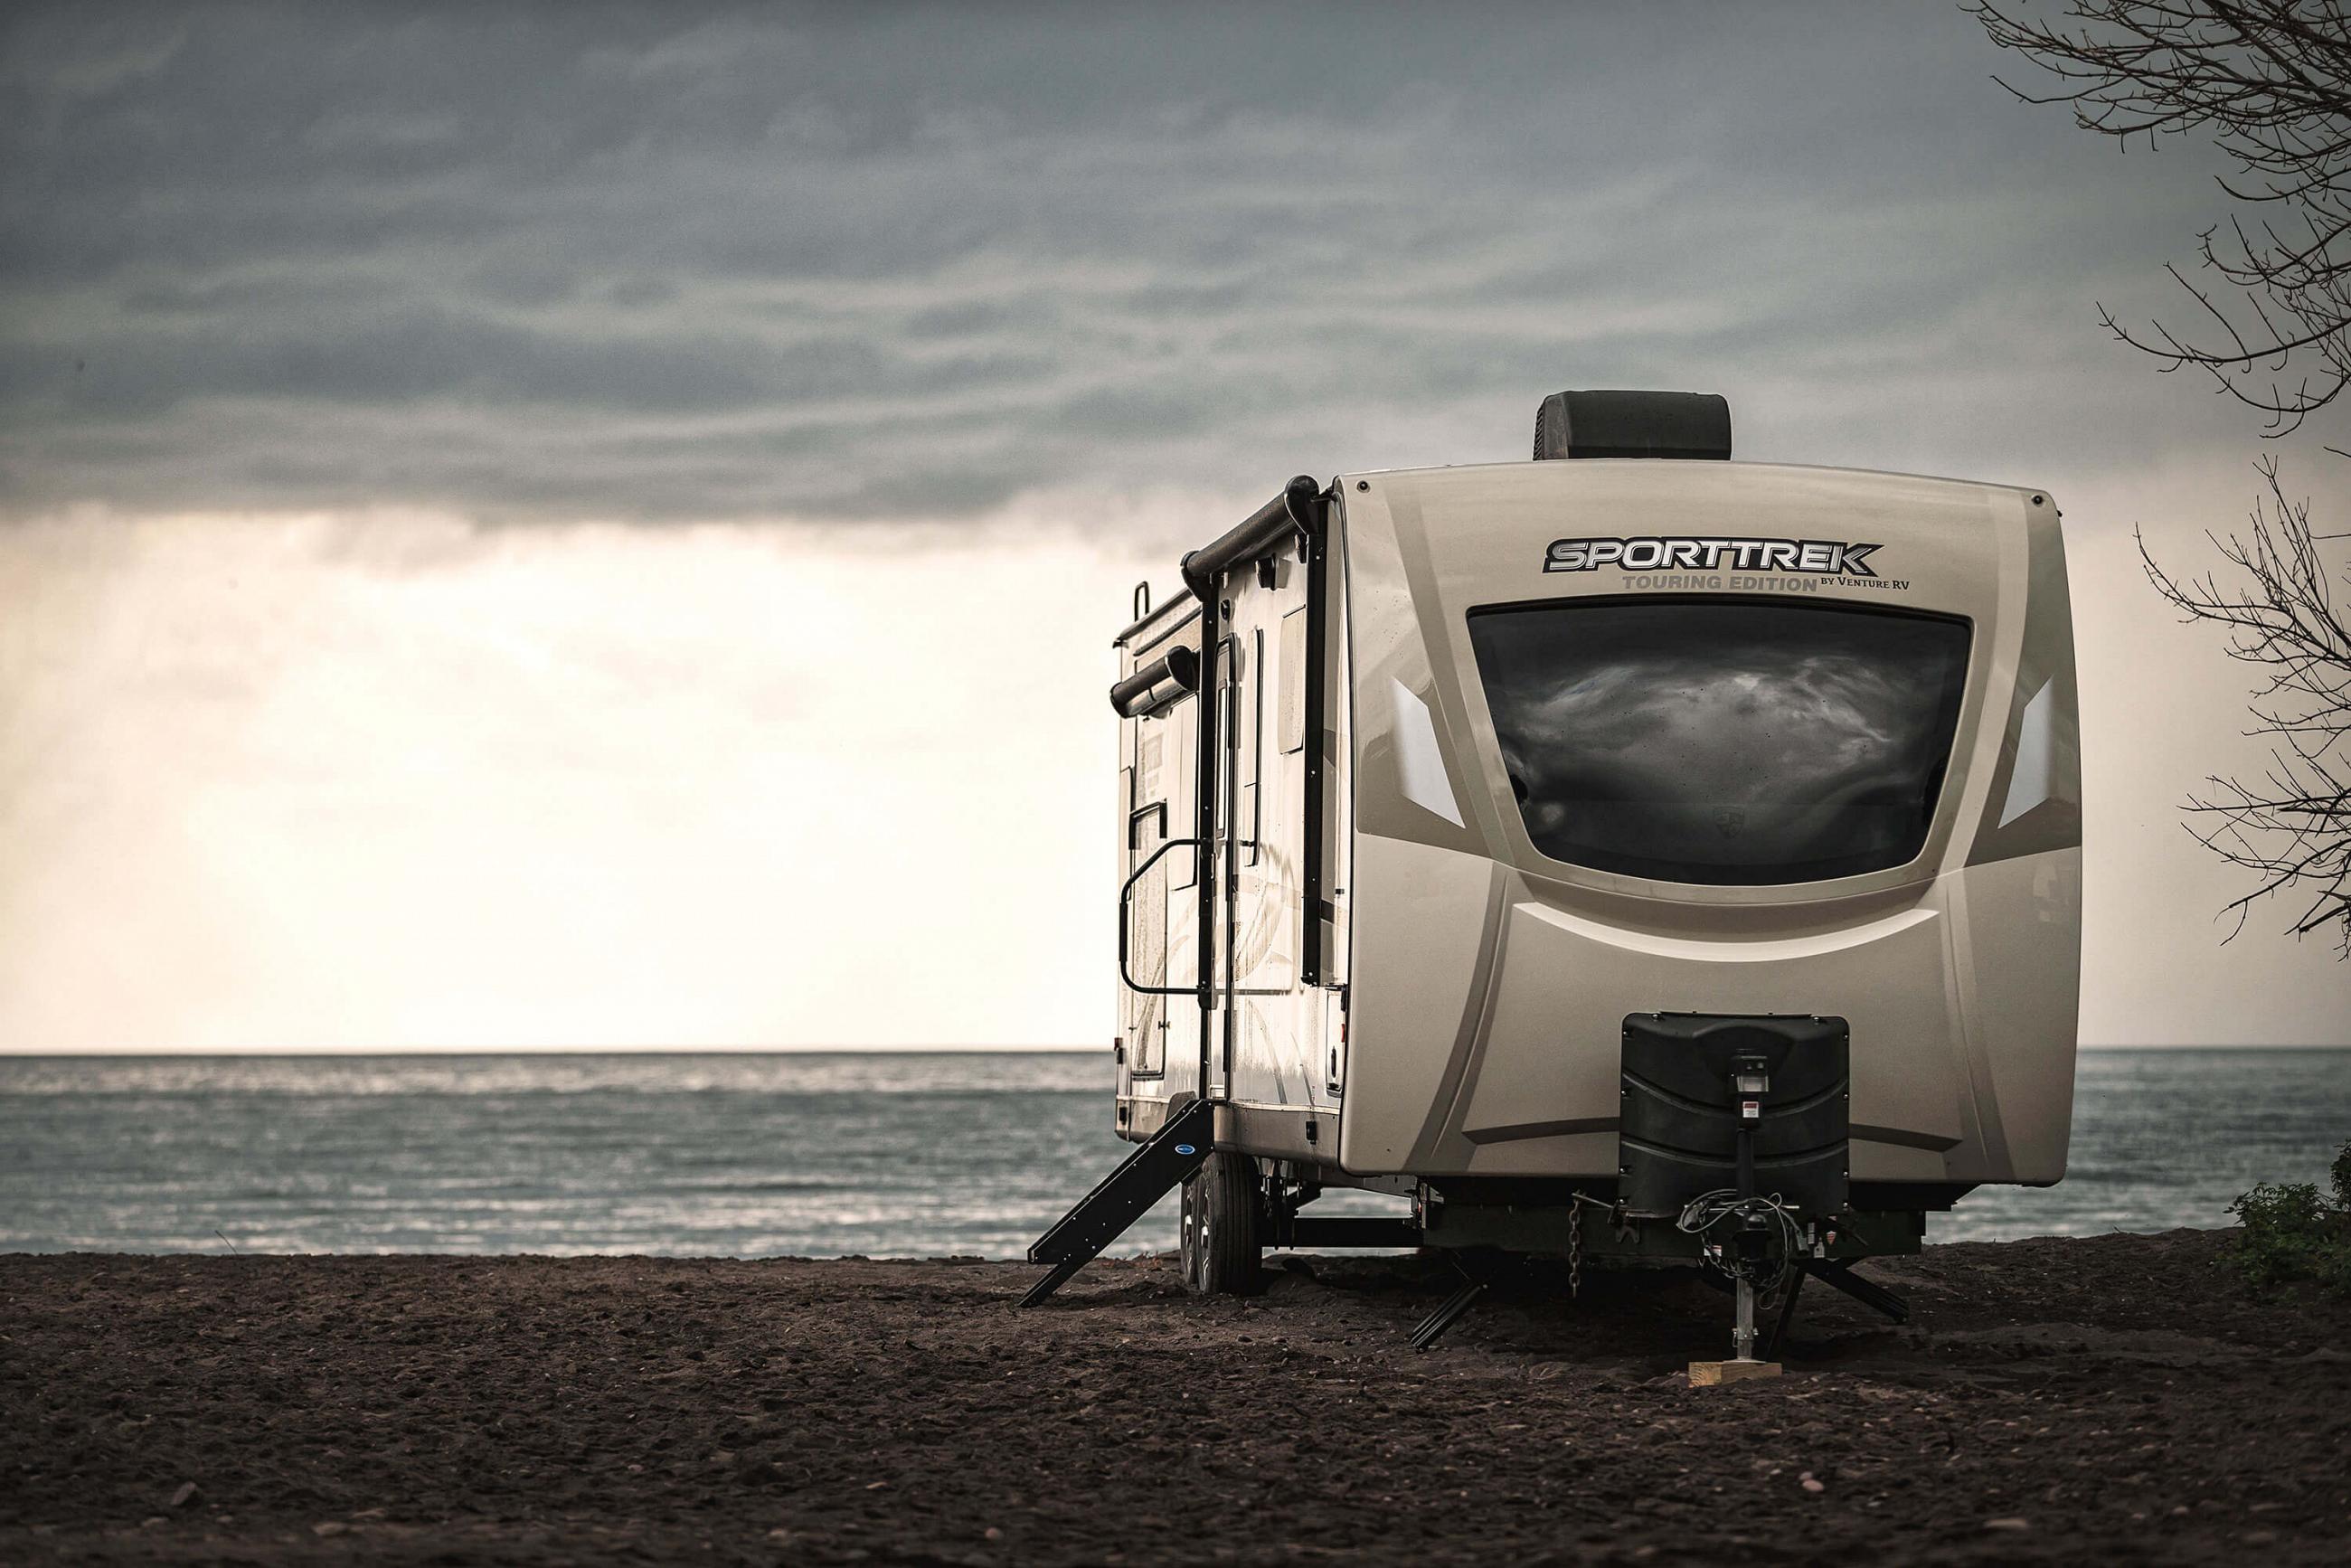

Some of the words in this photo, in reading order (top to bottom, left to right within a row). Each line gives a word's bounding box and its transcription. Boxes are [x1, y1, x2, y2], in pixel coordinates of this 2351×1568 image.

[1543, 537, 1884, 577] SPORTTREK
[1622, 575, 1722, 589] TOURING
[1729, 577, 1818, 592] EDITION
[1821, 577, 1835, 586] BY
[1893, 581, 1911, 590] RV
